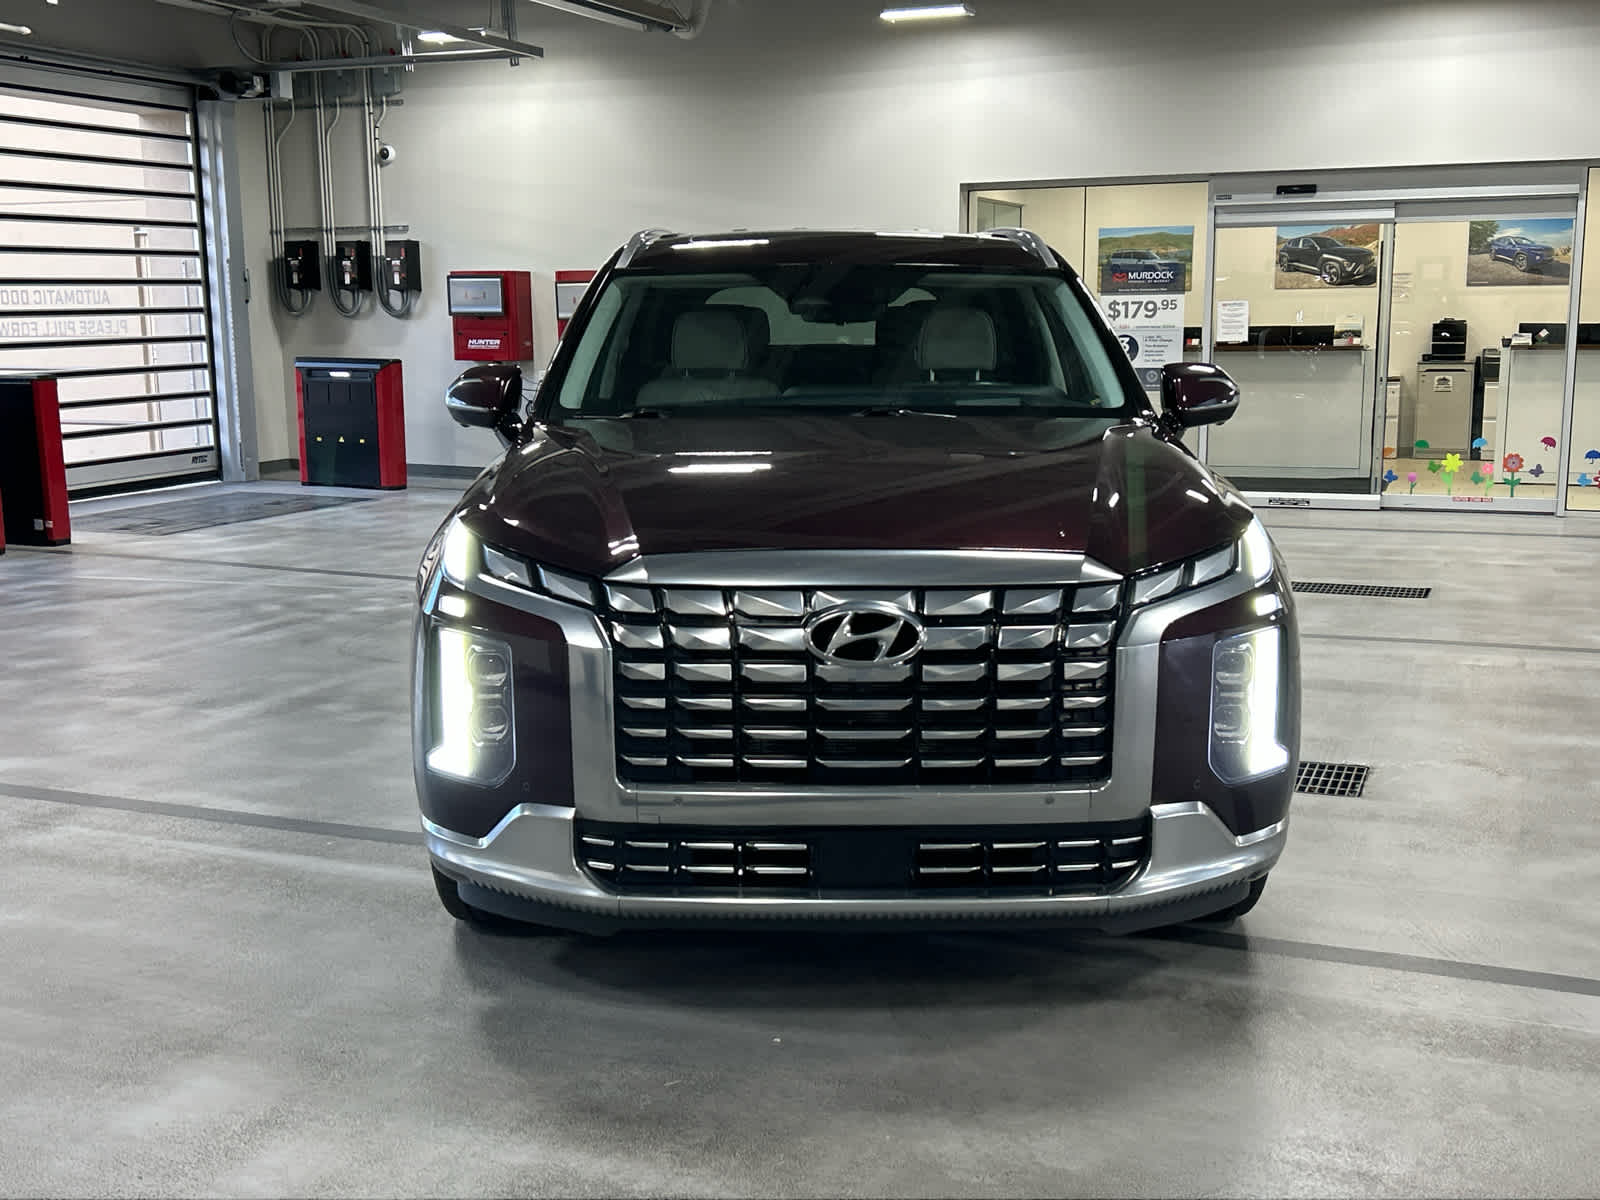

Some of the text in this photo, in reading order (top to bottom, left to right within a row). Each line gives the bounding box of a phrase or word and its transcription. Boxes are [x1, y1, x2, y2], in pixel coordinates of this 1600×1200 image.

[1128, 271, 1174, 280] MURDOCK
[1108, 300, 1178, 321] $179.95
[468, 338, 501, 346] HUNTER
